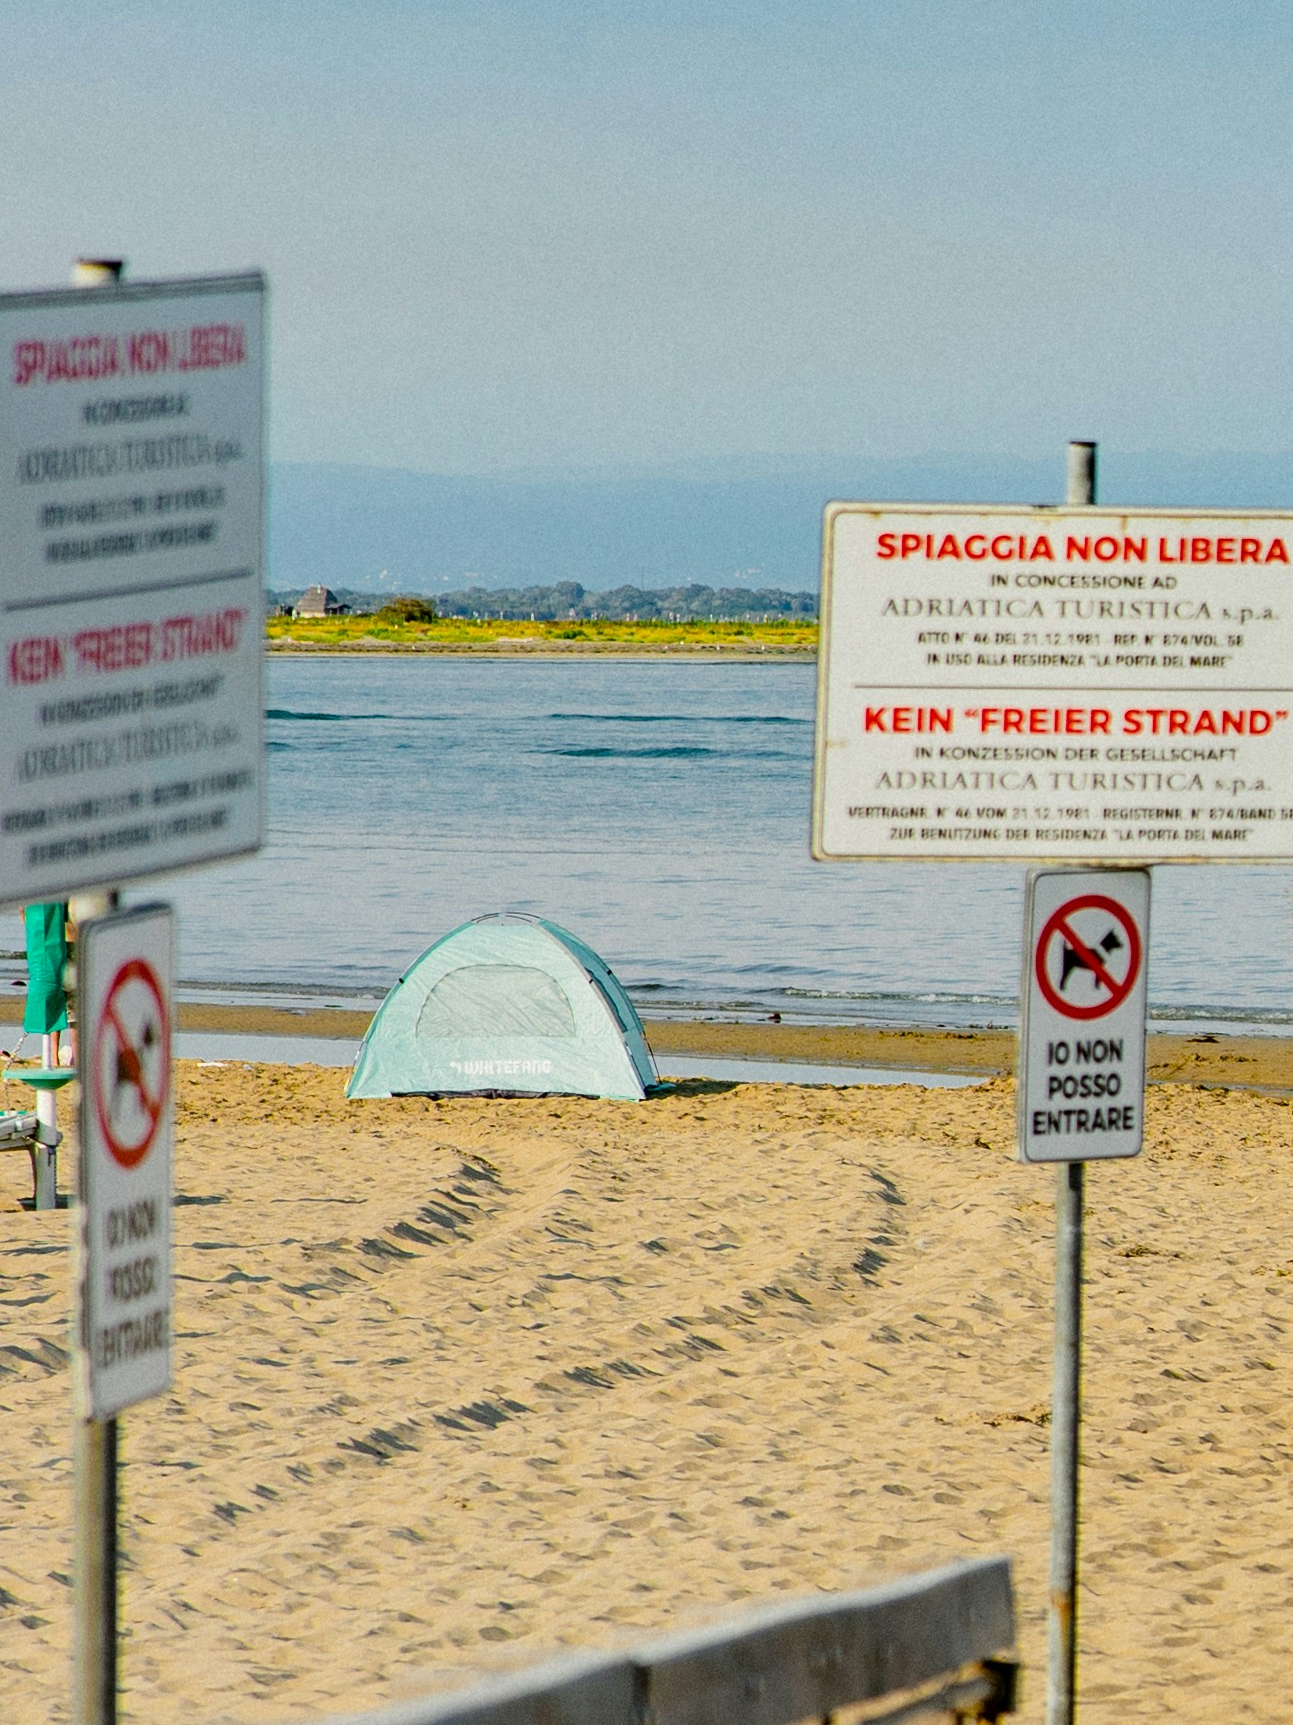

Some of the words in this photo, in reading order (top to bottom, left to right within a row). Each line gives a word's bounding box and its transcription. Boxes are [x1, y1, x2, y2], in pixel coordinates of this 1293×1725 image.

[877, 533, 1053, 561] SPIAGGIA
[1066, 536, 1146, 562] NON
[1159, 537, 1289, 564] LIBERA
[991, 576, 1008, 588] IN
[1016, 576, 1146, 590] CONCESSIONE
[1153, 576, 1176, 591] AD
[882, 599, 1044, 618] ADRIATICA
[1056, 600, 1211, 620] TURISTICA
[1222, 606, 1280, 625] s.p.a.
[918, 633, 950, 645] ATTO
[945, 654, 971, 666] USO
[976, 654, 1008, 666] ALLA
[1013, 654, 1085, 666] RESIDENZA
[1117, 655, 1158, 667] PORTA
[1163, 656, 1185, 667] DEL
[865, 708, 952, 732] KEIN
[915, 747, 933, 760] IN
[939, 747, 1057, 760] KONZESSION
[1065, 748, 1099, 760] DER
[1106, 749, 1237, 762] GESELLSCHAFT
[876, 772, 1038, 790] ADRIATICA
[1049, 773, 1203, 791] TURISTICA
[1215, 778, 1271, 796] s.p.a.
[977, 807, 1007, 820] VOM
[890, 829, 917, 840] ZUR
[922, 829, 1001, 841] BENUTZUNG
[1006, 829, 1031, 841] DER
[1035, 829, 1108, 841] RESIDENZA
[1139, 829, 1180, 841] PORTA
[1185, 830, 1207, 841] DEL
[1048, 1042, 1069, 1065] IO
[1076, 1039, 1123, 1064] NON
[1049, 1073, 1120, 1099] POSSO
[1033, 1106, 1134, 1136] ENTRARE
